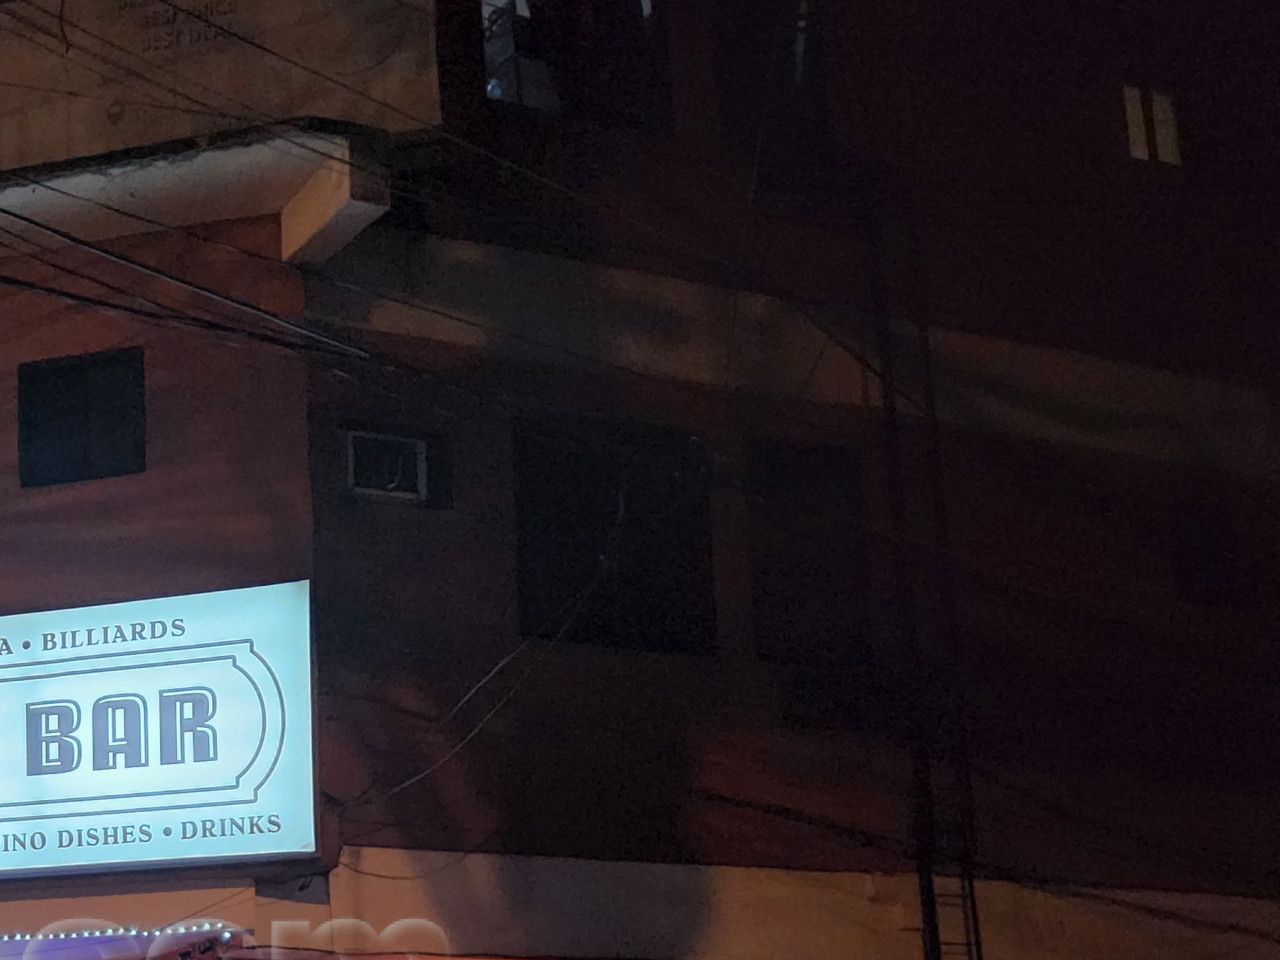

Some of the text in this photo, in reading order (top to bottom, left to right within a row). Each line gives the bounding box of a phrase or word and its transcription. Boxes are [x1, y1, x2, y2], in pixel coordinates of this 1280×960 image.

[41, 617, 186, 651] BILLIARDS
[25, 686, 218, 777] BAR
[57, 823, 153, 849] DISHES
[180, 813, 283, 840] DRINKS
